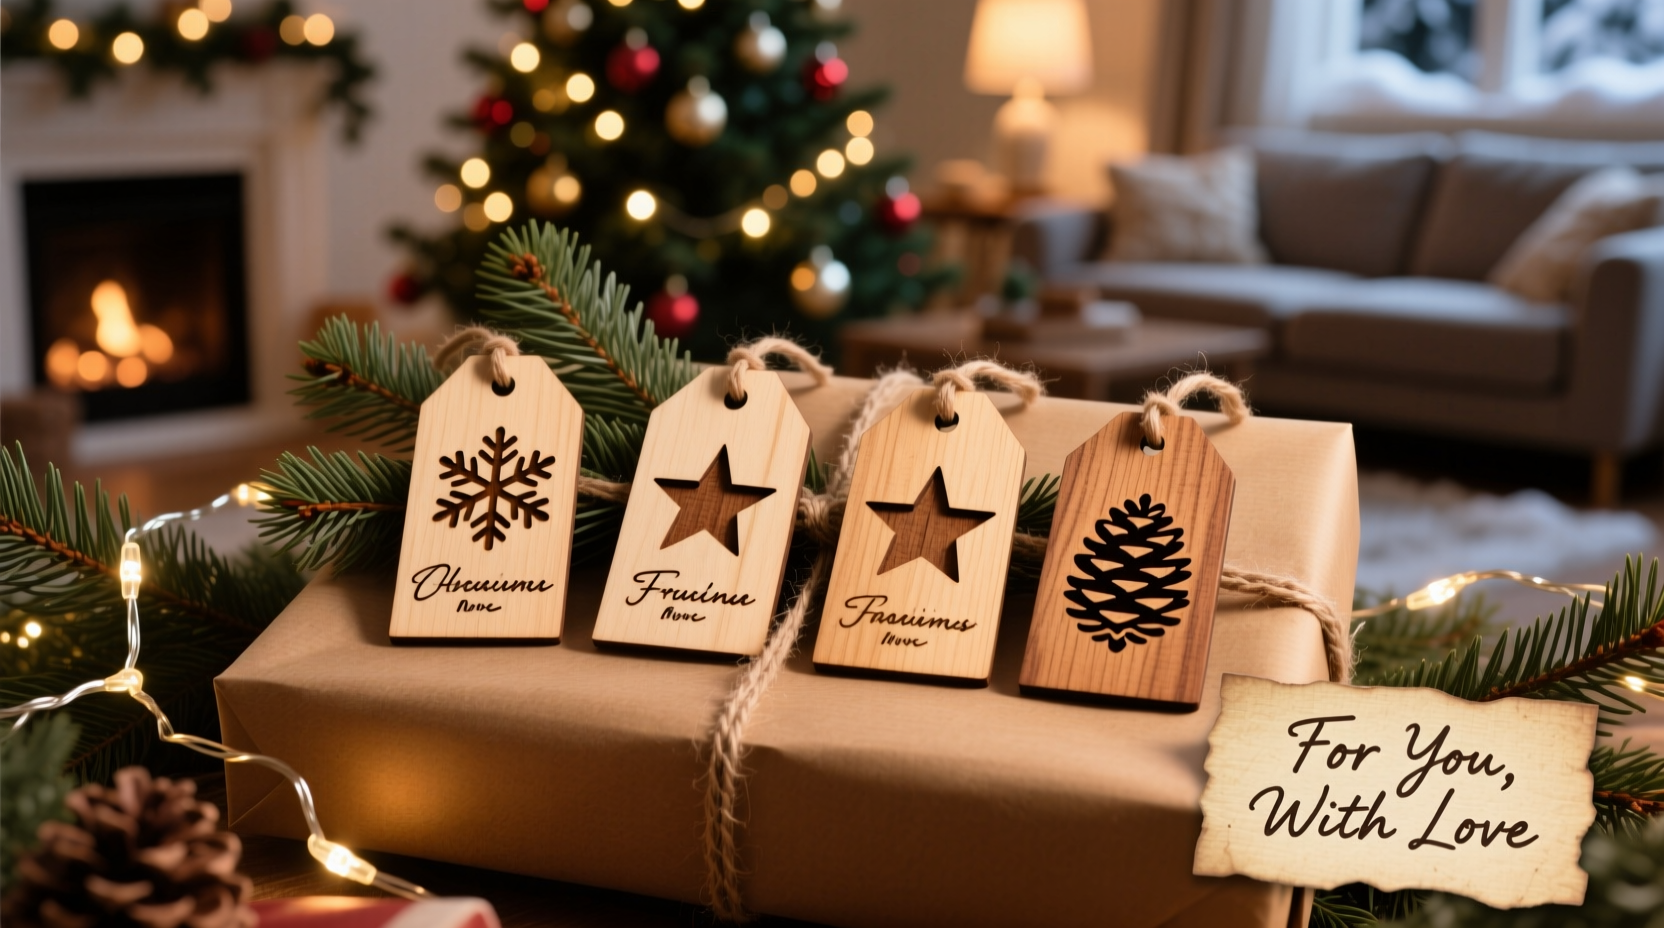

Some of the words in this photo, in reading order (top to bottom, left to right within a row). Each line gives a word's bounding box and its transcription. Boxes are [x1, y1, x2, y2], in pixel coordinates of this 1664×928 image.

[1287, 714, 1381, 774] For
[1395, 722, 1515, 799] You,
[1248, 784, 1397, 840] With
[1408, 788, 1540, 851] Love
